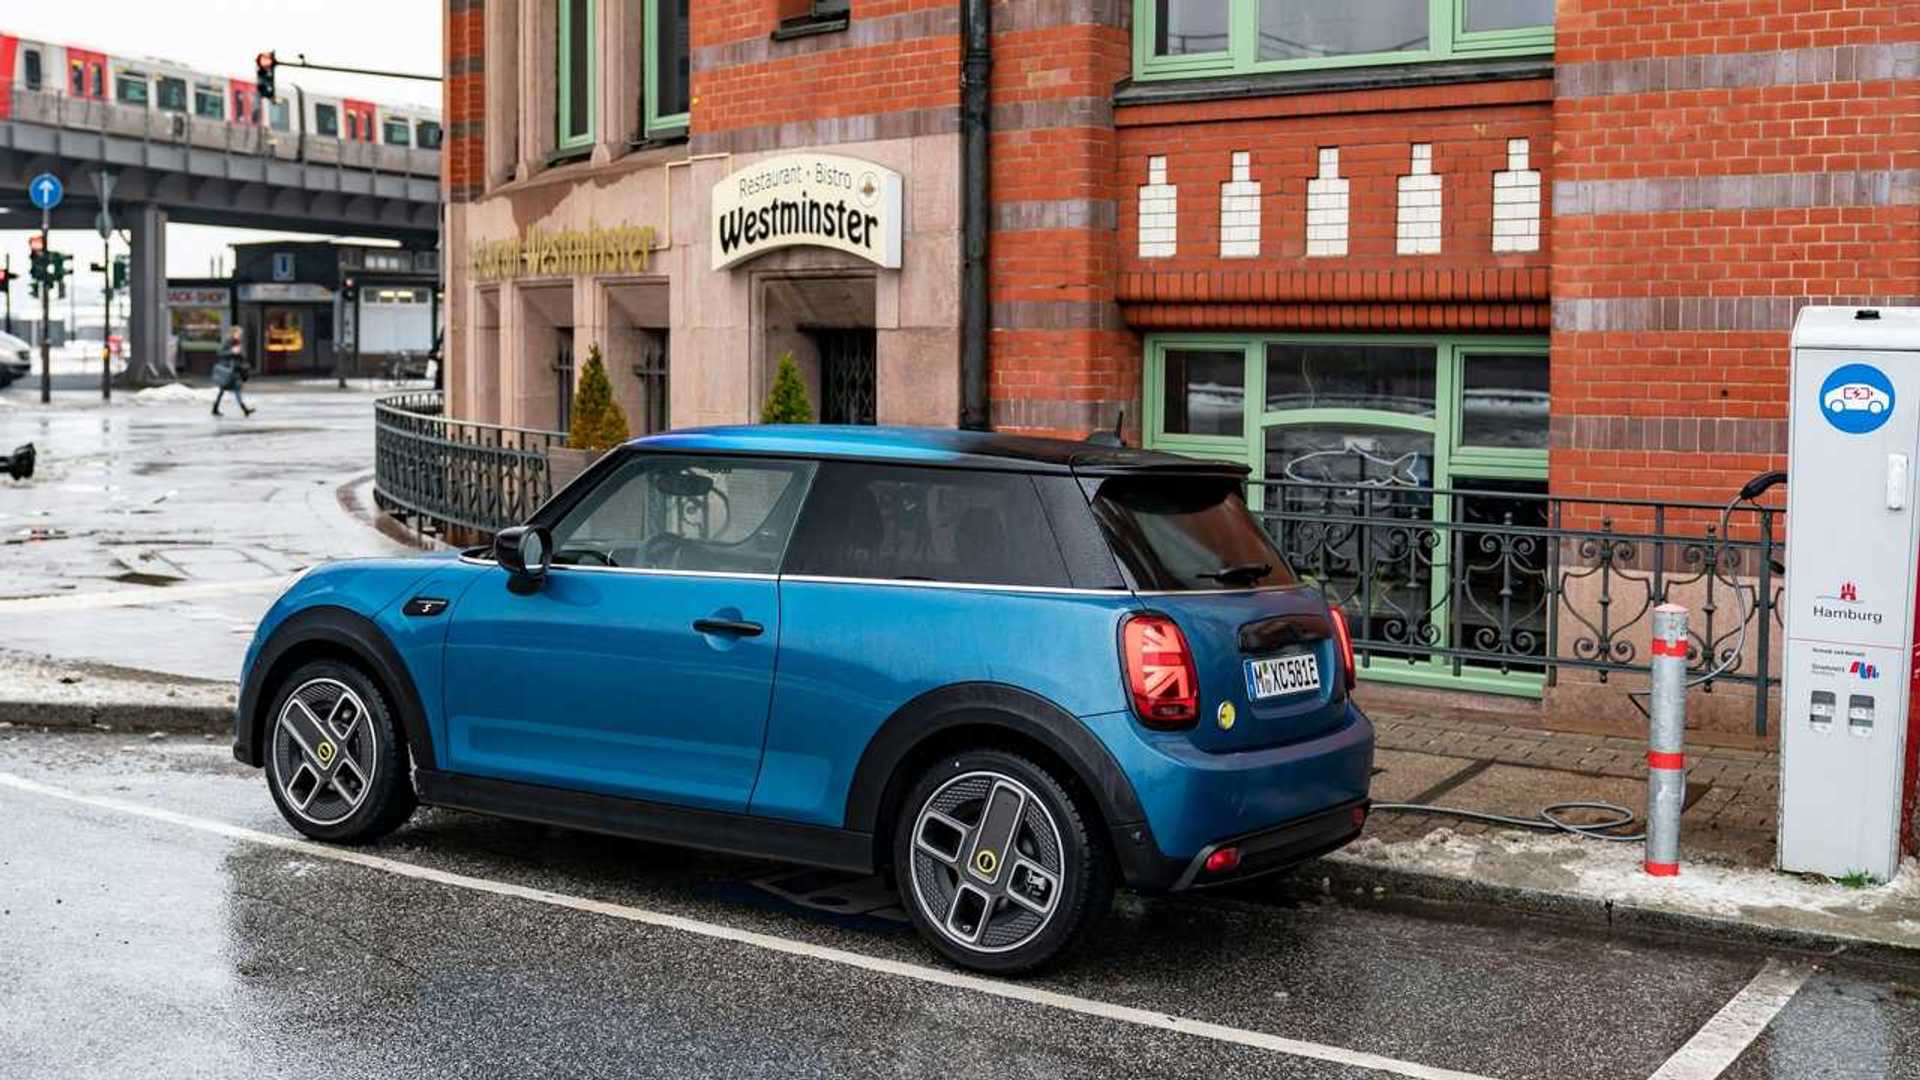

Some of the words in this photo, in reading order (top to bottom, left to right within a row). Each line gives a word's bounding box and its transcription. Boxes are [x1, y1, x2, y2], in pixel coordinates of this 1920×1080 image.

[739, 165, 804, 198] Restaurant
[815, 162, 853, 190] Bistro
[719, 189, 879, 255] Westminster
[1813, 605, 1883, 624] Hamburg
